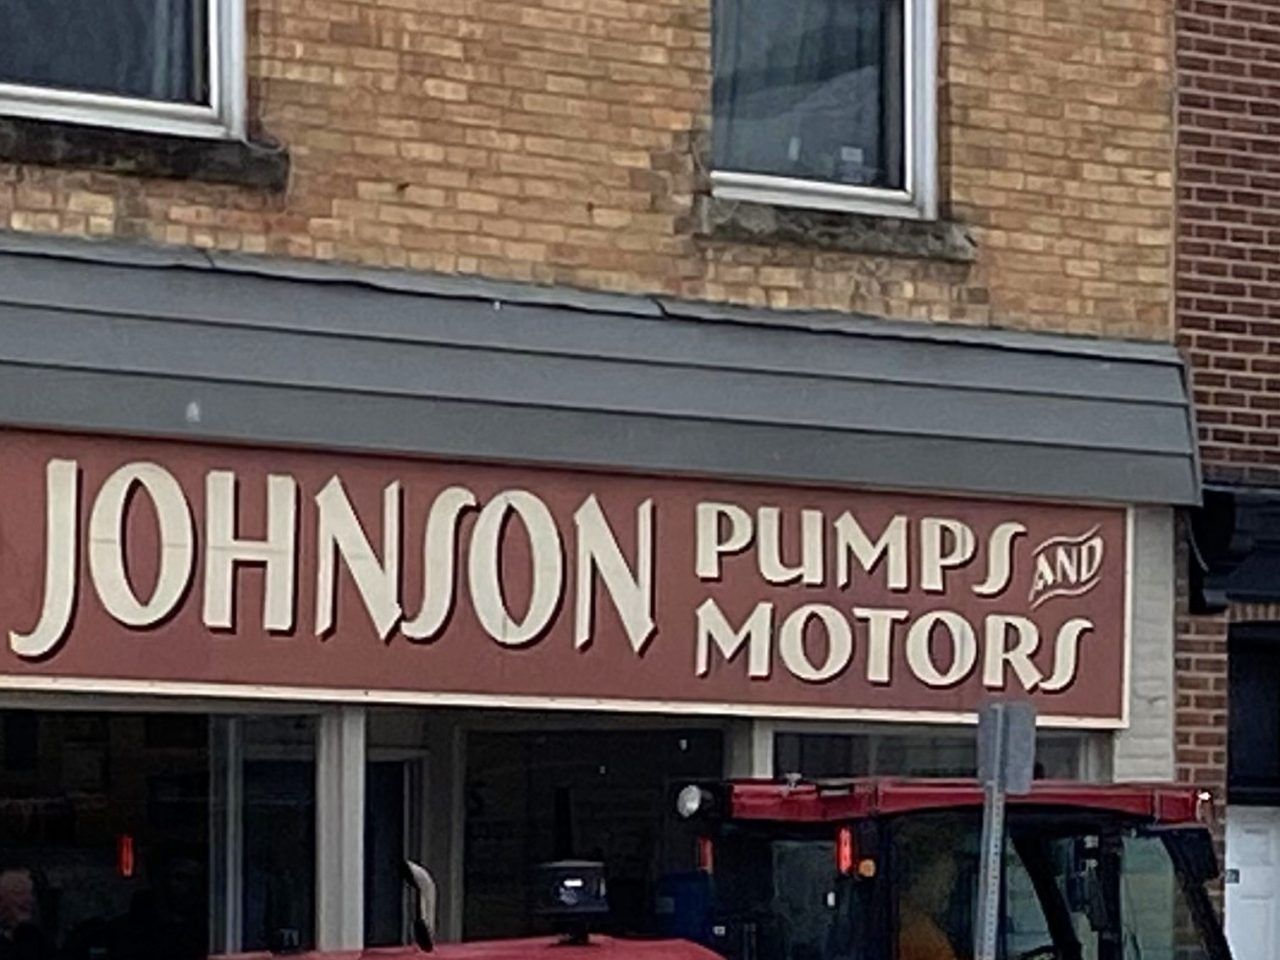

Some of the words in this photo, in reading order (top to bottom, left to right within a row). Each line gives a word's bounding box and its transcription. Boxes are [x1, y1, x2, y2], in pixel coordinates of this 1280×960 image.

[10, 459, 657, 659] JOHNSON
[696, 502, 1027, 595] PUMPS
[1032, 536, 1104, 592] AND
[696, 598, 1094, 692] MOTORS
